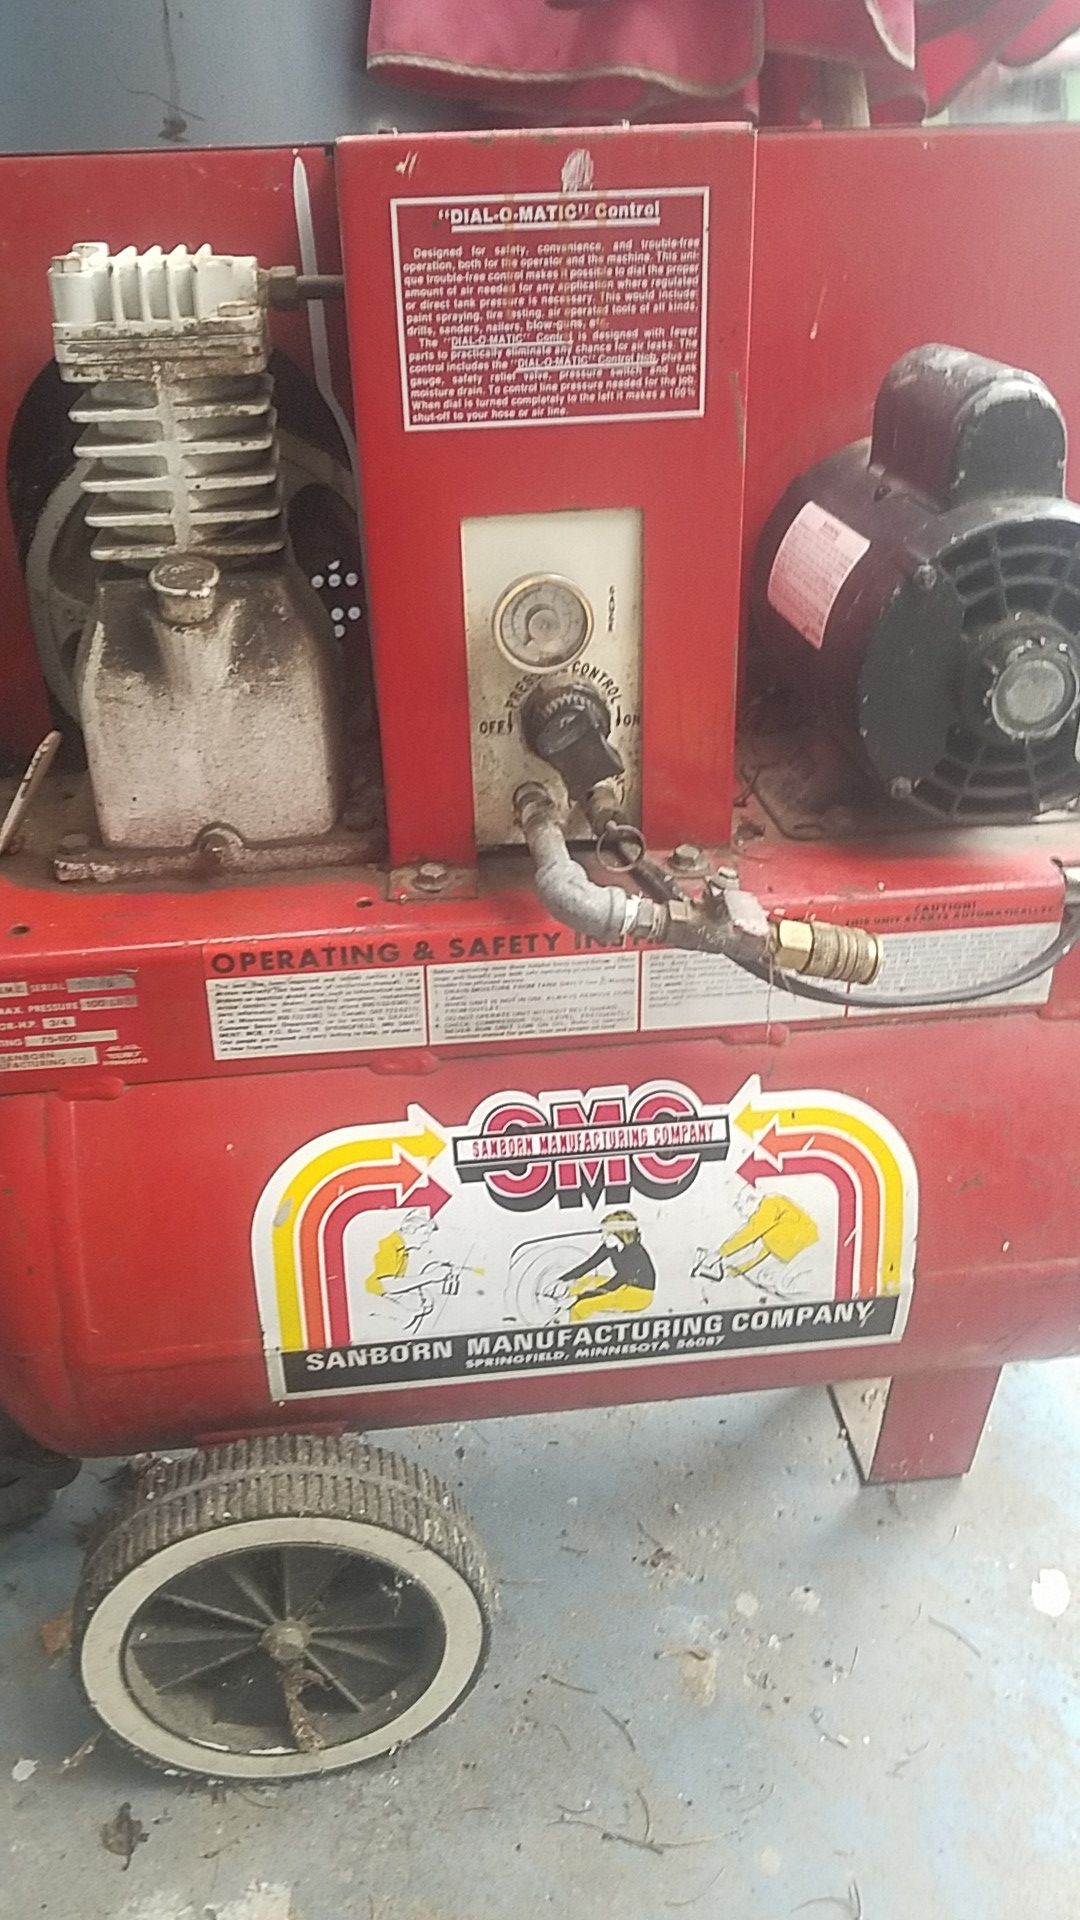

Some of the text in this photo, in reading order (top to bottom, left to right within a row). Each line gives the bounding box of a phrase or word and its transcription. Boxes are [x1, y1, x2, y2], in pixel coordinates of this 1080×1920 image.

[438, 201, 659, 224] "DIAL-O-MATIC" Control
[413, 246, 463, 261] Designed
[471, 245, 486, 256] for
[494, 243, 529, 257] safety,
[612, 239, 632, 250] and
[640, 236, 700, 249] trouble-free
[402, 260, 455, 274] operation,
[457, 259, 481, 270] both
[484, 258, 498, 269] for
[500, 257, 518, 268] the
[519, 255, 563, 269] operator
[565, 254, 585, 266] and
[587, 254, 604, 265] the
[656, 250, 677, 262] This
[403, 276, 424, 287] que
[425, 272, 486, 285] trouble-free
[487, 270, 523, 282] control
[525, 268, 558, 280] makes
[569, 266, 612, 280] possible
[614, 266, 625, 277] to
[626, 265, 645, 276] dial
[647, 264, 664, 275] the
[665, 264, 699, 276] proper
[404, 286, 443, 298] amount
[446, 286, 457, 297] of
[460, 285, 474, 296] air
[477, 283, 515, 295] needed
[518, 282, 532, 293] for
[536, 283, 554, 294] any
[616, 277, 648, 289] where
[650, 275, 699, 289] regulated
[404, 302, 416, 311] or
[419, 299, 450, 311] direct
[453, 298, 476, 309] tank
[479, 297, 525, 310] pressure
[528, 295, 537, 306] is
[600, 291, 621, 303] This
[624, 290, 655, 302] would
[405, 312, 432, 326] paint
[435, 310, 483, 324] spraying,
[485, 309, 503, 320] tire
[547, 307, 561, 317] air
[563, 305, 608, 319] operated
[611, 303, 636, 315] tools
[639, 303, 649, 313] of
[652, 302, 665, 313] all
[406, 325, 436, 338] drills,
[438, 323, 483, 337] sanders,
[485, 321, 523, 335] nailers,
[525, 318, 586, 333] blow-guns,
[418, 337, 438, 348] The
[577, 330, 587, 341] is
[592, 328, 638, 342] designed
[643, 327, 665, 338] with
[669, 325, 698, 337] fewer
[407, 350, 434, 363] parts
[436, 349, 448, 360] to
[450, 347, 503, 361] practically
[505, 345, 552, 357] eliminate
[554, 345, 572, 356] any
[575, 342, 612, 353] chance
[614, 341, 628, 352] for
[631, 340, 644, 351] air
[679, 338, 697, 349] The
[408, 362, 445, 374] control
[445, 360, 489, 372] includes
[491, 359, 508, 370] the
[597, 353, 634, 365] Control
[661, 351, 682, 363] plus
[684, 350, 697, 361] air
[409, 376, 445, 388] gauge,
[451, 373, 482, 386] safety
[489, 371, 516, 382] relief
[558, 369, 603, 381] pressure
[610, 365, 642, 377] switch
[649, 364, 668, 375] and
[675, 363, 697, 374] tank
[410, 387, 455, 399] moisture
[487, 385, 501, 395] To
[502, 383, 537, 394] control
[539, 382, 558, 392] line
[560, 381, 604, 393] pressure
[606, 378, 642, 389] needed
[644, 377, 658, 387] for
[660, 376, 676, 387] the
[410, 400, 441, 411] When
[442, 399, 462, 409] dial
[463, 398, 473, 408] is
[475, 396, 508, 408] turned
[510, 394, 565, 408] completely
[566, 393, 577, 403] to
[579, 392, 595, 403] the
[597, 391, 613, 402] left
[625, 389, 657, 400] makes
[659, 390, 666, 399] a
[411, 411, 450, 423] shut-off
[453, 411, 464, 421] to
[466, 411, 489, 422] your
[491, 408, 515, 419] hose
[517, 409, 528, 418] or
[531, 407, 545, 417] air
[504, 661, 622, 709] PRESS CONTROL
[479, 719, 506, 734] OFF
[623, 714, 640, 727] ON
[211, 943, 400, 974] OPERATING
[413, 940, 434, 961] &
[448, 932, 561, 959] SAFETY
[472, 1121, 715, 1160] SANBORN MANUFACTURING COMPANY
[305, 1301, 873, 1371] SANBORN MANUFACTURING COMPANY
[465, 1335, 725, 1369] SPRINGFIELD, MINNESOTA 56087
